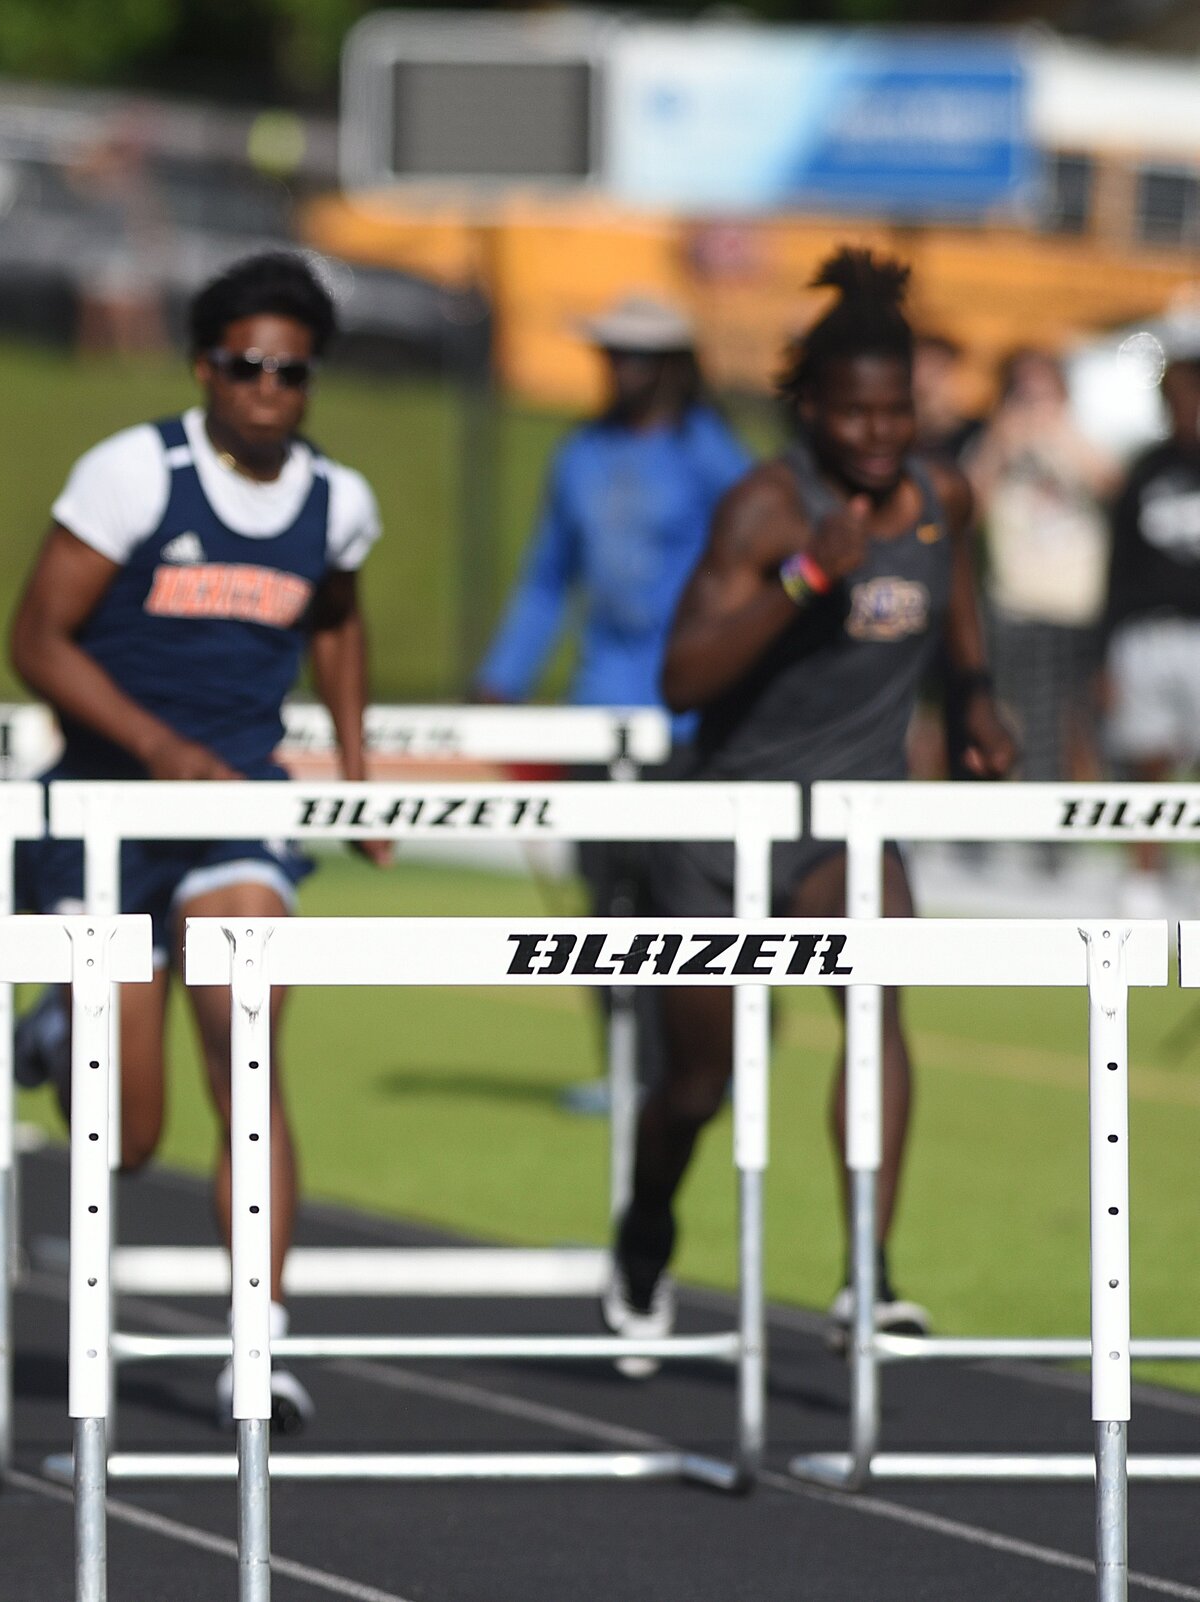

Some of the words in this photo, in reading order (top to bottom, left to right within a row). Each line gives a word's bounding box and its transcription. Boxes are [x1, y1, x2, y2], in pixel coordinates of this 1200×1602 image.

[298, 797, 554, 828] BLAZER
[1059, 797, 1200, 829] BLA
[505, 933, 855, 975] BLAZER
